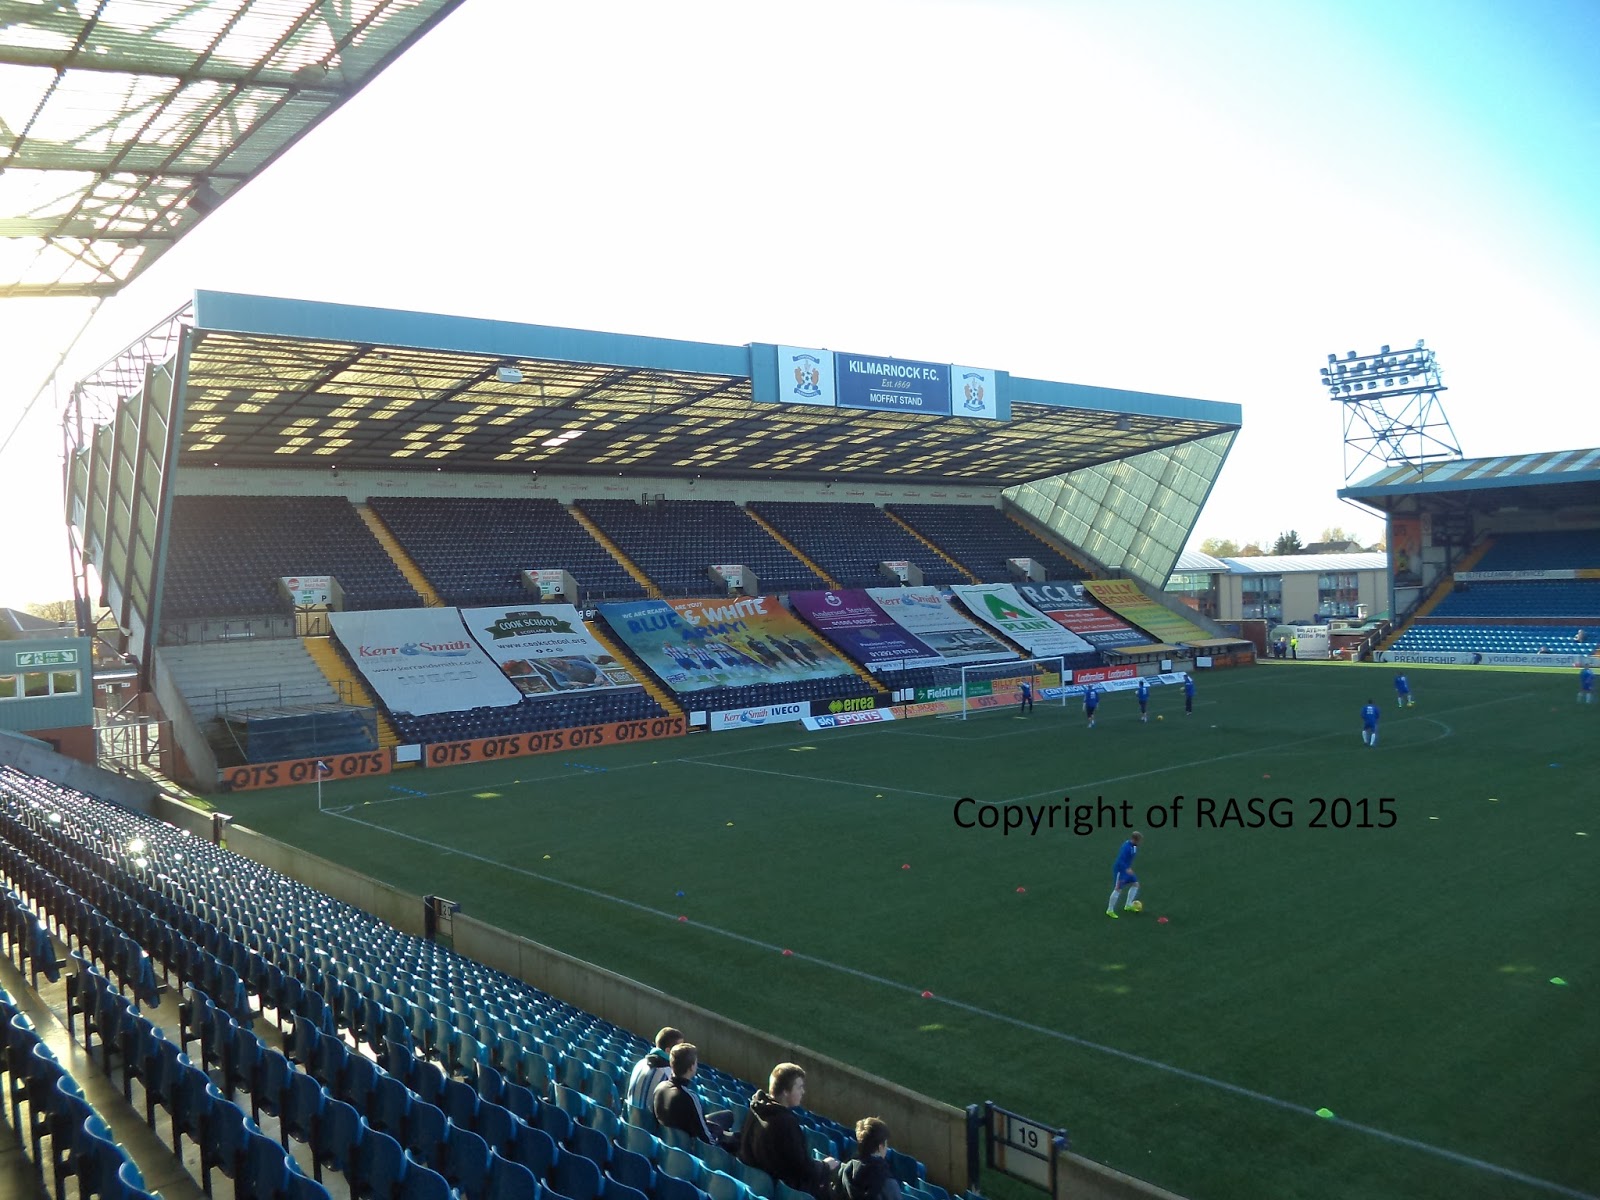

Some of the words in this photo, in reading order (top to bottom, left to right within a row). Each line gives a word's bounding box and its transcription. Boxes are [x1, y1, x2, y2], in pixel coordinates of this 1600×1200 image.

[849, 360, 921, 379] KILMARNOCK
[923, 368, 940, 381] F.C.
[881, 379, 894, 388] Est.
[894, 381, 911, 389] 1869
[869, 393, 898, 404] MOFFAT
[899, 395, 923, 406] STAND
[1092, 584, 1133, 595] BILLY
[876, 596, 900, 605] Kerr
[911, 593, 941, 604] Smith
[701, 598, 768, 623] WHITE
[499, 620, 523, 631] COOK
[523, 618, 558, 627] SCHOOL
[626, 612, 682, 634] BLUE
[682, 620, 749, 640] ARMY!
[1000, 621, 1054, 631] PLANT
[358, 645, 399, 657] Kerr
[419, 640, 471, 652] Smith
[496, 638, 587, 649] www.cookschool.org
[372, 659, 483, 673] www.kerrandsmith.co.uk
[1394, 655, 1456, 664] PREMIERSHIP
[1077, 671, 1105, 682] Ladbrokes
[1107, 669, 1134, 679] Ladbrokes
[927, 685, 962, 699] FieldTurf
[843, 695, 875, 712] errea
[723, 712, 740, 722] Kerr
[748, 708, 768, 718] Smith
[771, 705, 800, 716] IVECO
[818, 716, 835, 727] sky
[838, 711, 881, 724] SPORTS
[432, 742, 471, 763] QTS
[482, 736, 520, 758] QTS
[528, 731, 564, 752] QTS
[569, 727, 603, 747] QTS
[615, 721, 647, 741] QTS
[651, 717, 683, 736] QTS
[231, 764, 279, 788] QTS
[289, 758, 334, 782] QTS
[340, 753, 384, 775] QTS
[1018, 1127, 1038, 1149] 19
